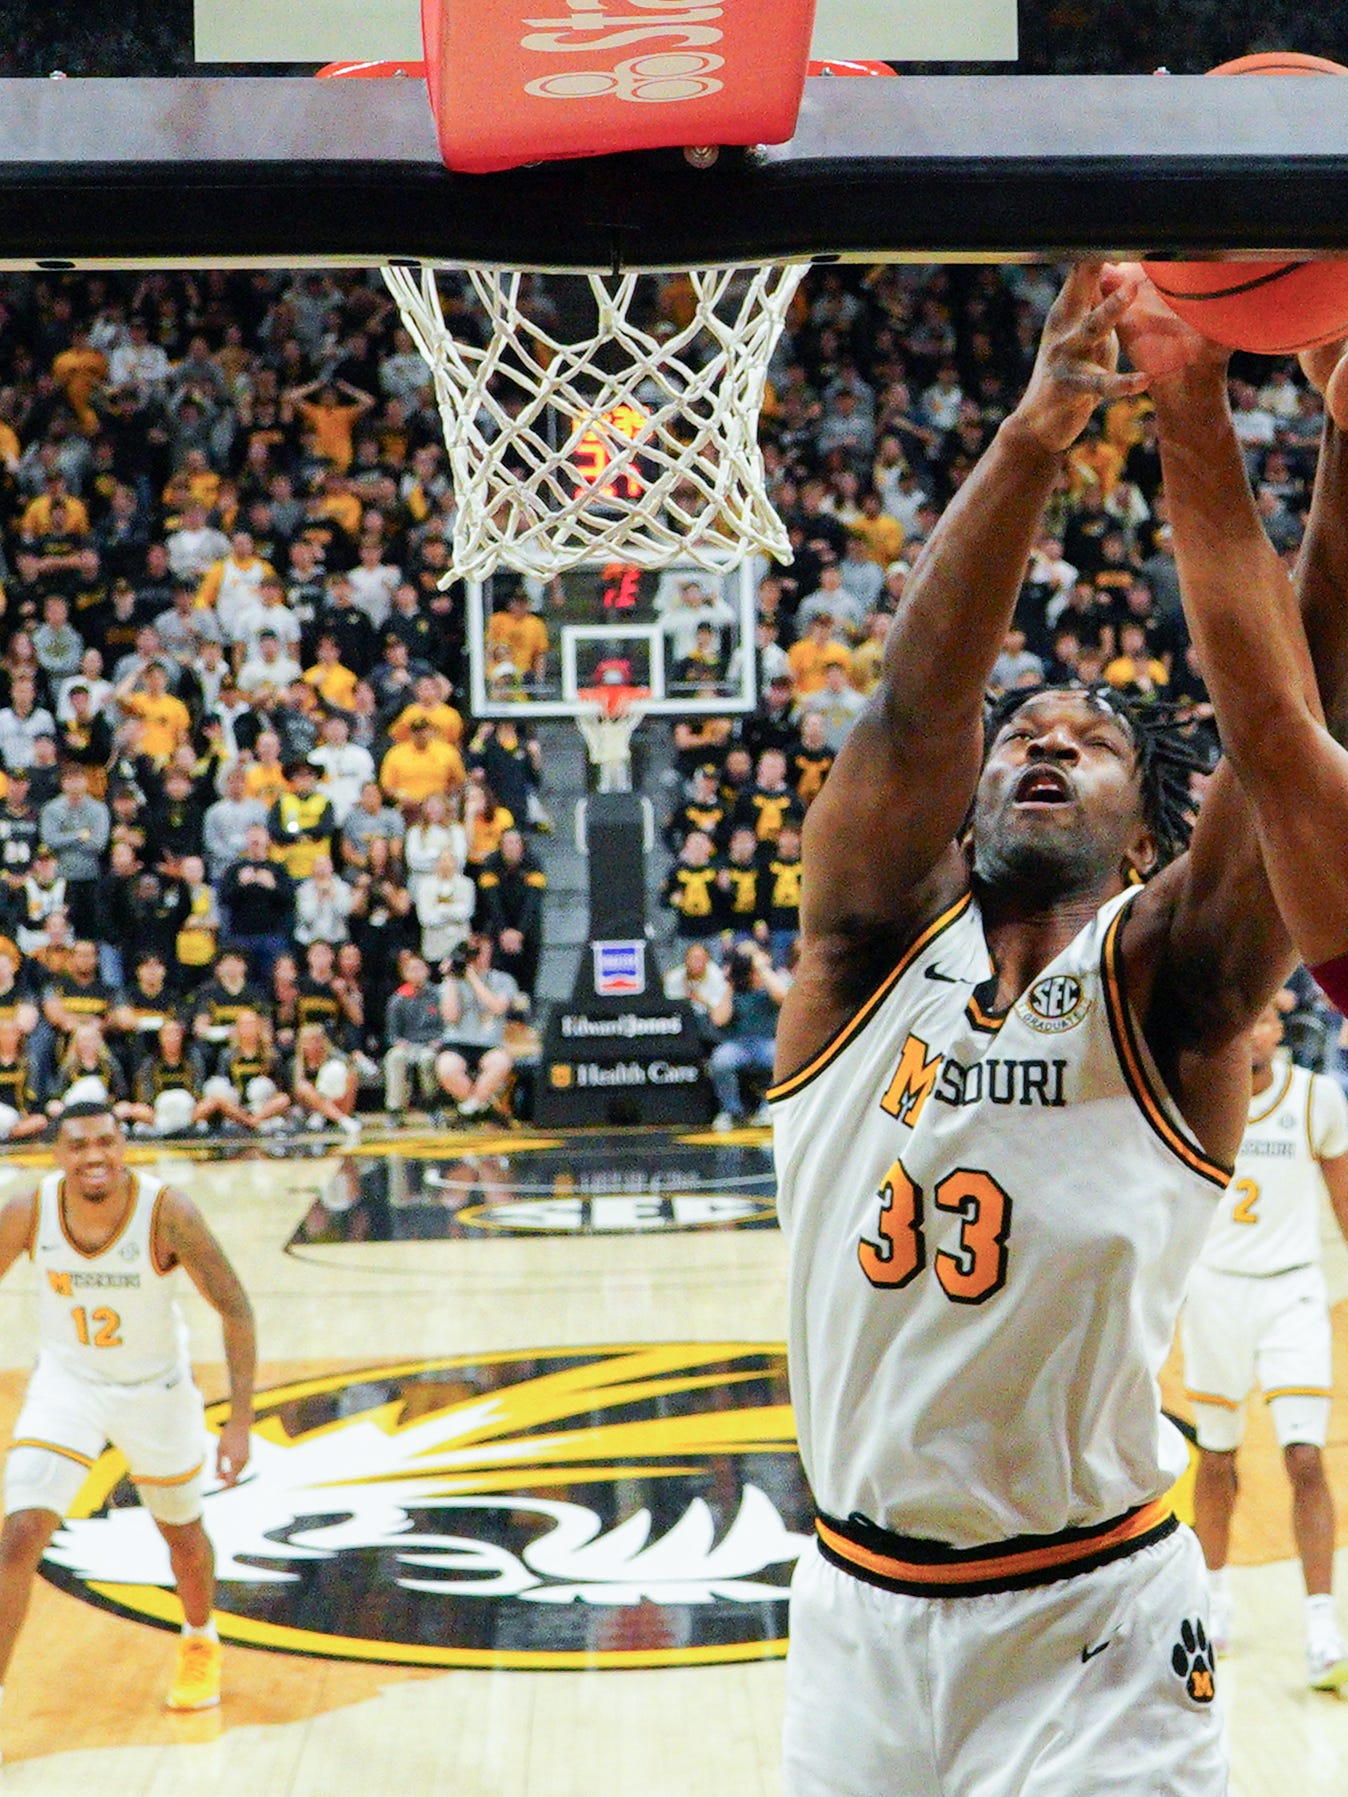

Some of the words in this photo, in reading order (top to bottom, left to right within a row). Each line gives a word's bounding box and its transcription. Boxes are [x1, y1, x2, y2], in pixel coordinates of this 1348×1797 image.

[1031, 977, 1080, 1016] SEC
[1232, 1177, 1260, 1225] 2
[858, 1158, 1013, 1305] 33
[71, 1305, 123, 1348] 12
